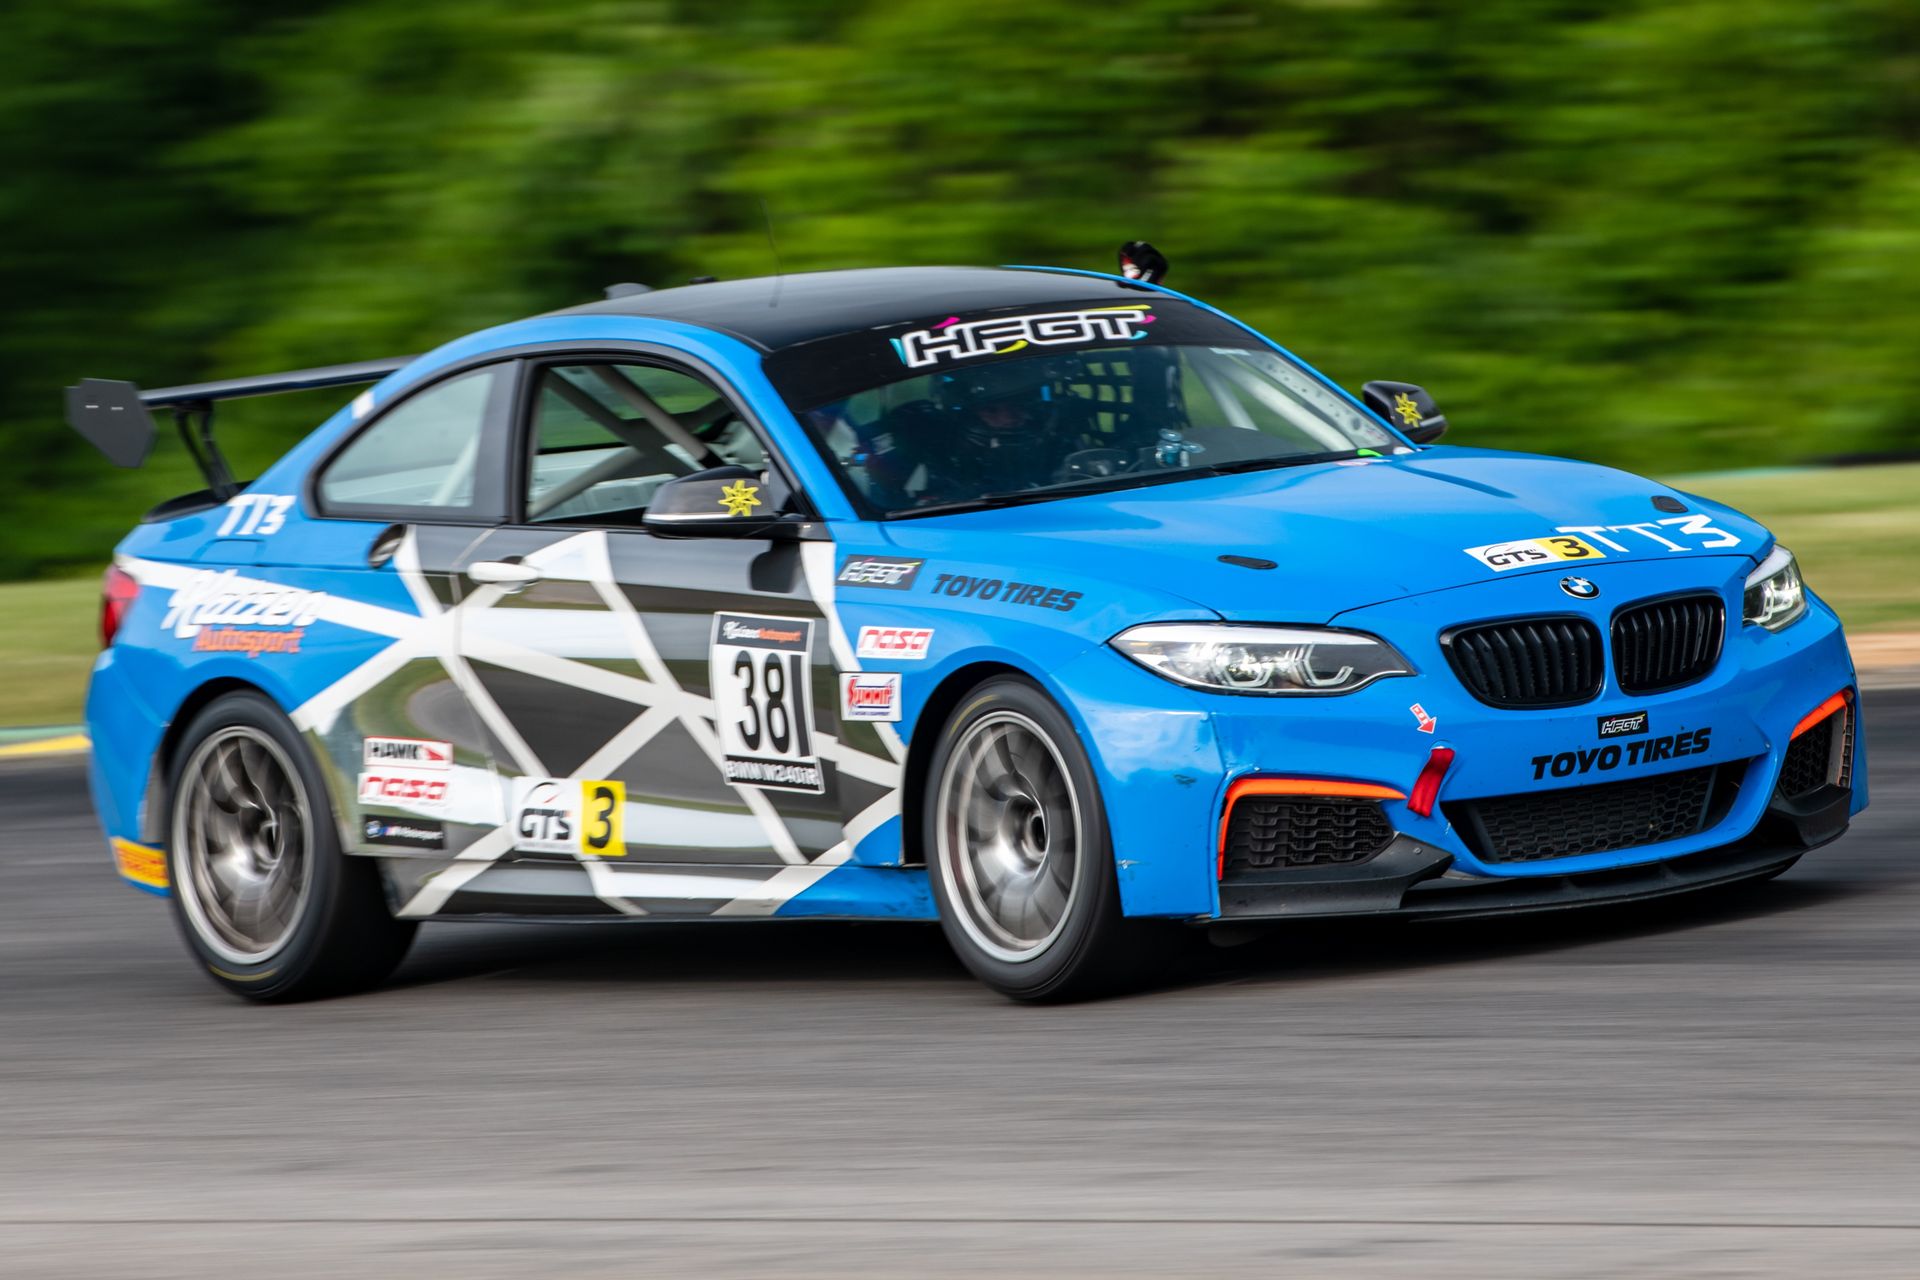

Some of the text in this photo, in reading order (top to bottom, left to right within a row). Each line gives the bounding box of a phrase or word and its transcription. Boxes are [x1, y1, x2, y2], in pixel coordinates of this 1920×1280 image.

[901, 310, 1145, 368] HFGT
[216, 494, 296, 536] TT3
[1555, 514, 1741, 552] TT3
[1486, 538, 1589, 566] GTS 3
[931, 574, 1084, 612] TOYO TIRES
[1601, 716, 1643, 734] HFGT
[1531, 727, 1711, 780] TOYO TIRES
[519, 786, 615, 848] GTS 3
